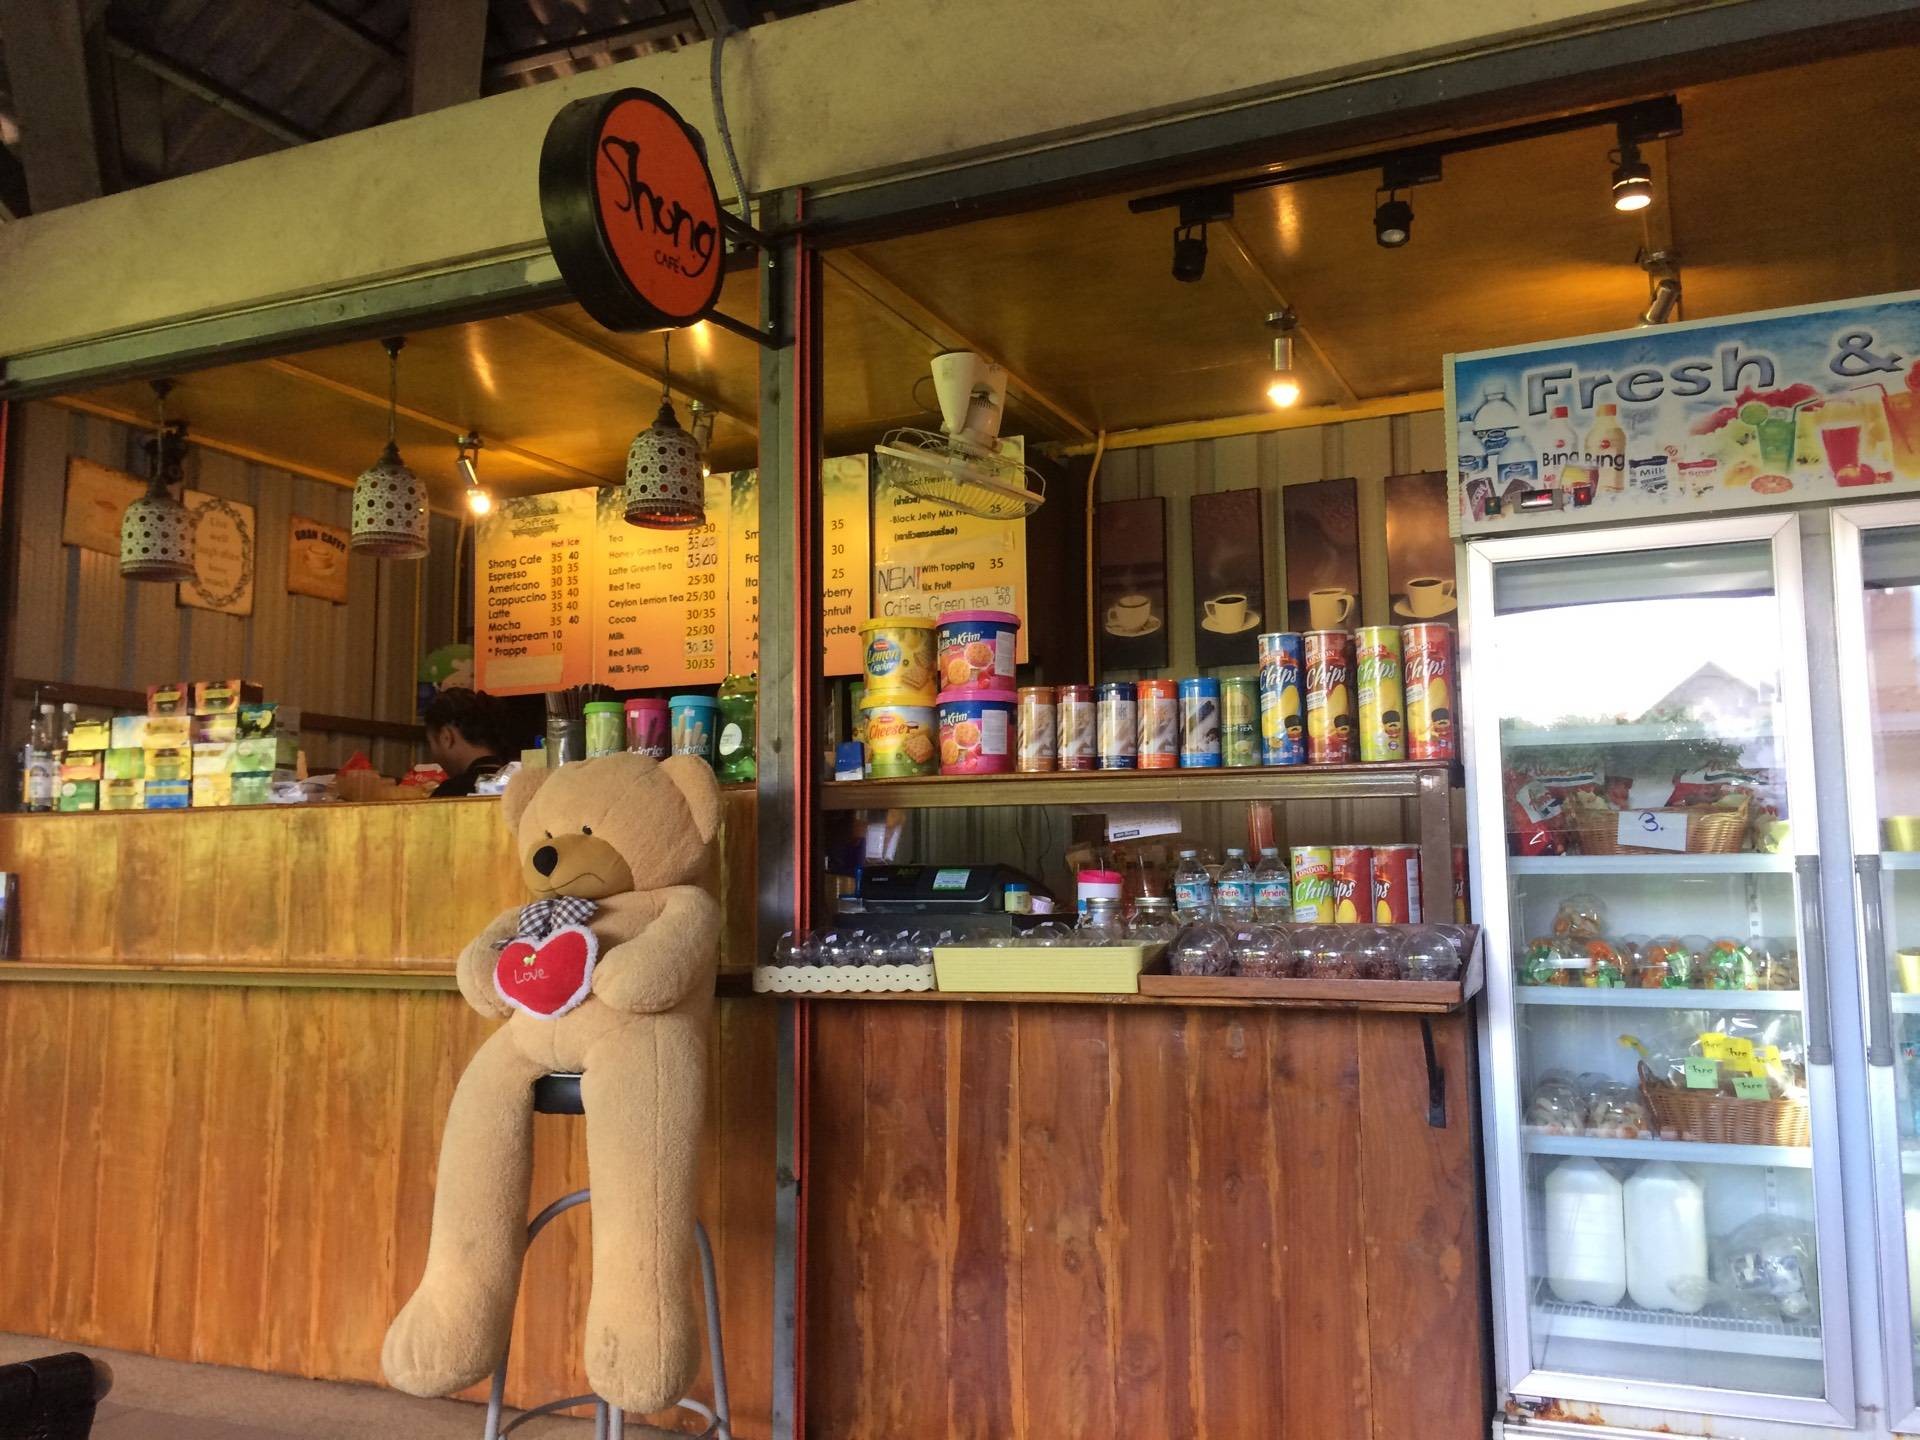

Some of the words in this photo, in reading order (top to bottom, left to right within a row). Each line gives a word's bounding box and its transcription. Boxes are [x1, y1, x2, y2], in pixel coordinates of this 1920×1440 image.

[602, 136, 716, 278] Shong
[1527, 346, 1775, 417] Fresh
[1829, 331, 1904, 377] &
[1639, 466, 1666, 477] Milk
[918, 512, 936, 521] Jelly
[939, 509, 953, 518] Mix
[831, 519, 844, 531] 35
[638, 546, 663, 556] Green
[665, 544, 679, 553] Tea
[831, 544, 844, 556] 30
[488, 558, 517, 570] Shong
[519, 554, 542, 566] Cafe
[551, 552, 562, 563] 35
[568, 551, 579, 560] 40
[921, 564, 939, 574] With
[941, 561, 975, 572] Topping
[989, 558, 1004, 569] 35
[488, 570, 527, 583] Espresso
[551, 565, 563, 575] 30
[567, 562, 578, 573] 35
[608, 565, 628, 576] Latte
[630, 563, 656, 574] Green
[658, 562, 673, 571] Tea
[831, 568, 845, 580] 25
[488, 581, 540, 595] Americano
[551, 577, 563, 587] 30
[567, 575, 578, 586] 35
[608, 582, 624, 592] Red
[626, 581, 641, 590] Tea
[934, 581, 952, 591] Fruit
[994, 585, 1010, 595] Ice
[488, 592, 547, 607] Cappuccino
[551, 590, 562, 601] 35
[567, 587, 579, 598] 40
[608, 596, 638, 609] Ceylon
[639, 594, 668, 606] Lemon
[669, 592, 684, 602] Tea
[686, 590, 716, 602] 25/30
[488, 609, 510, 619] Latte
[551, 602, 563, 612] 35
[566, 600, 578, 611] 40
[884, 597, 921, 617] Coffee
[928, 595, 966, 611] Green
[971, 596, 989, 608] tea
[488, 620, 521, 632] Mocha
[550, 616, 562, 627] 35
[568, 615, 580, 625] 40
[608, 615, 637, 625] Cocoa
[686, 608, 716, 620] 30/35
[494, 630, 549, 644] Whipcream
[552, 630, 563, 639] 10
[608, 632, 625, 641] Milk
[686, 625, 715, 637] 25/30
[824, 624, 857, 638] ychee
[494, 646, 528, 657] Frappe
[551, 642, 563, 652] 10
[608, 648, 624, 658] Red
[626, 646, 643, 656] Milk
[867, 649, 898, 662] Lemon
[608, 665, 625, 674] Milk
[626, 663, 650, 675] Syrup
[685, 658, 716, 670] 30/35
[1357, 659, 1397, 686] Chips
[1405, 657, 1446, 686] Chips
[1260, 664, 1298, 693] Chips
[1307, 662, 1346, 691] Chips
[869, 724, 906, 740] Cheese
[1295, 864, 1326, 878] LONDON
[1295, 878, 1335, 903] Chip
[514, 968, 551, 985] Love
